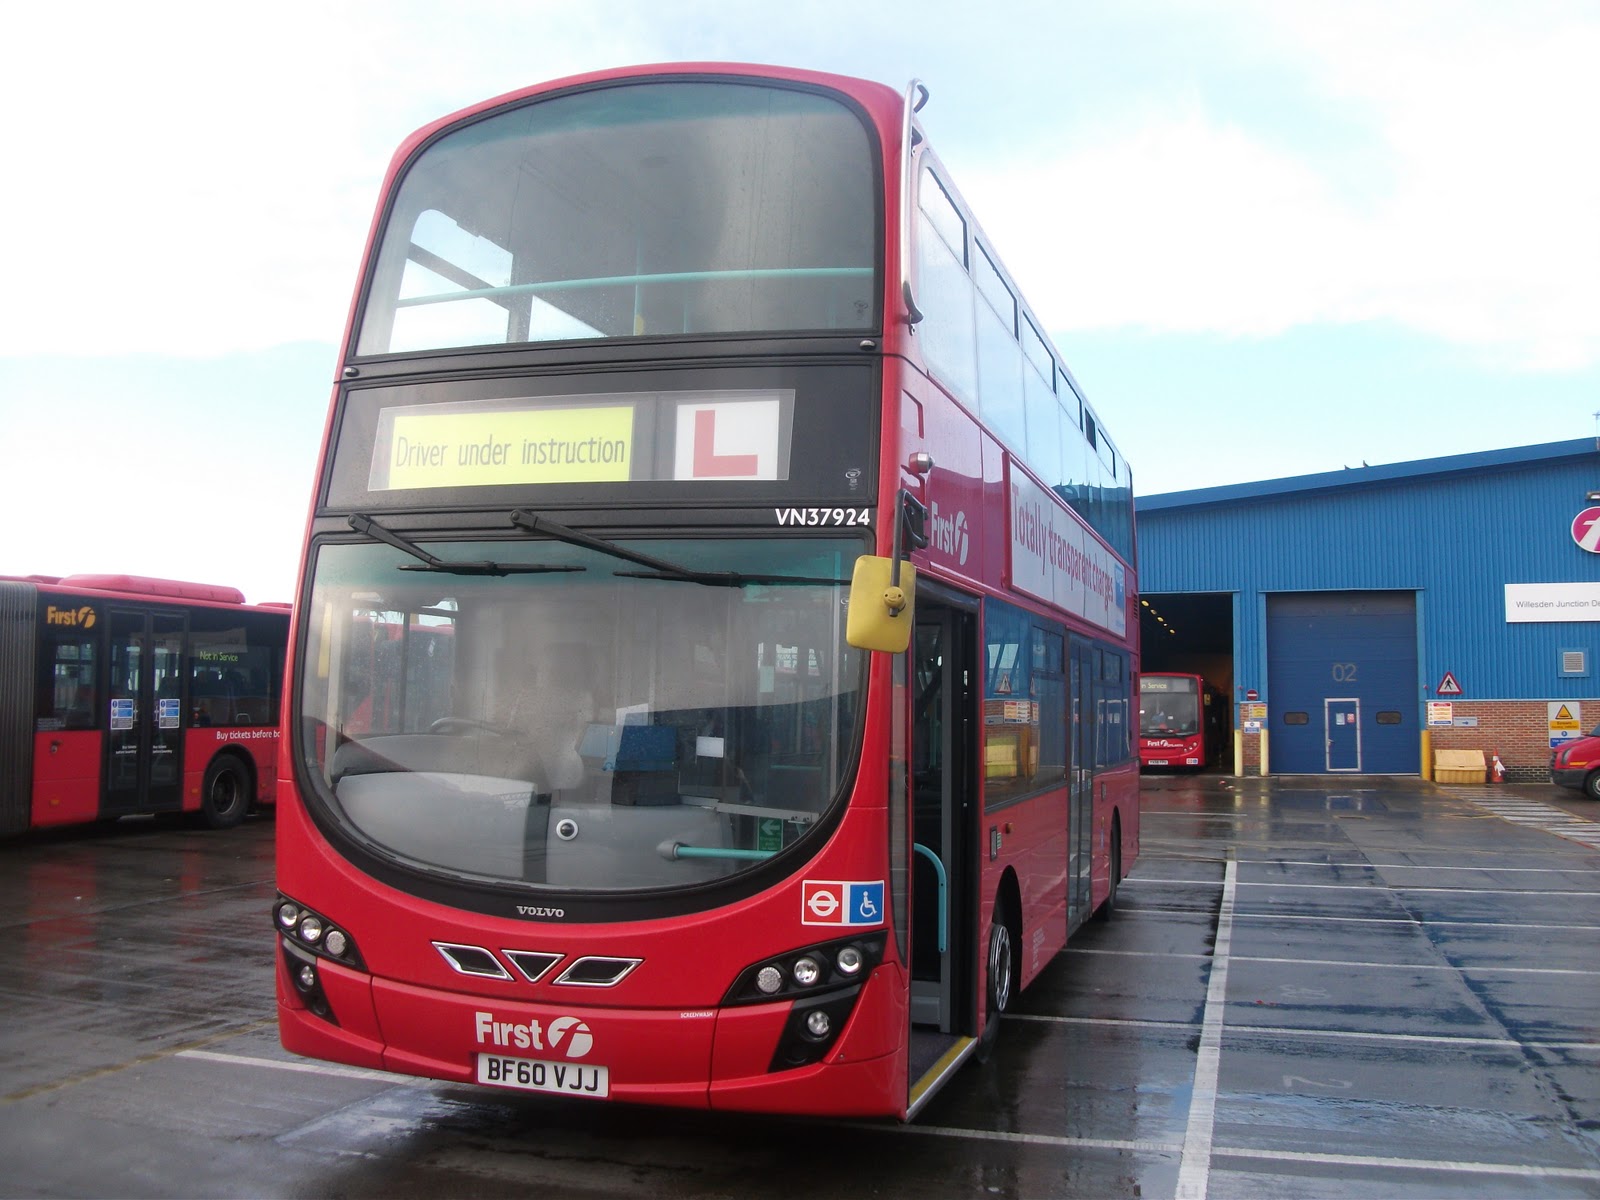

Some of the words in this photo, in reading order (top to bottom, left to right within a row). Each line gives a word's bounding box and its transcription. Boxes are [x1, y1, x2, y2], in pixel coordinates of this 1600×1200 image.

[396, 435, 448, 467] Driver
[458, 434, 511, 466] under
[521, 437, 625, 465] instruction
[693, 410, 758, 478] L
[775, 508, 870, 526] VN37924
[931, 501, 954, 556] First
[1011, 482, 1047, 575] Totally
[1048, 520, 1092, 591] transparent
[1092, 553, 1114, 611] charges
[1556, 600, 1589, 608] Junction
[47, 605, 77, 626] First
[200, 651, 212, 660] Not
[213, 652, 219, 660] in
[219, 652, 238, 661] Service
[1333, 664, 1358, 682] 02
[216, 731, 228, 741] Buy
[230, 731, 251, 739] tickets
[252, 730, 272, 738] before
[516, 905, 565, 918] VOLVO
[475, 1011, 544, 1050] First
[487, 1057, 546, 1086] BF60
[553, 1065, 598, 1091] VJJ
